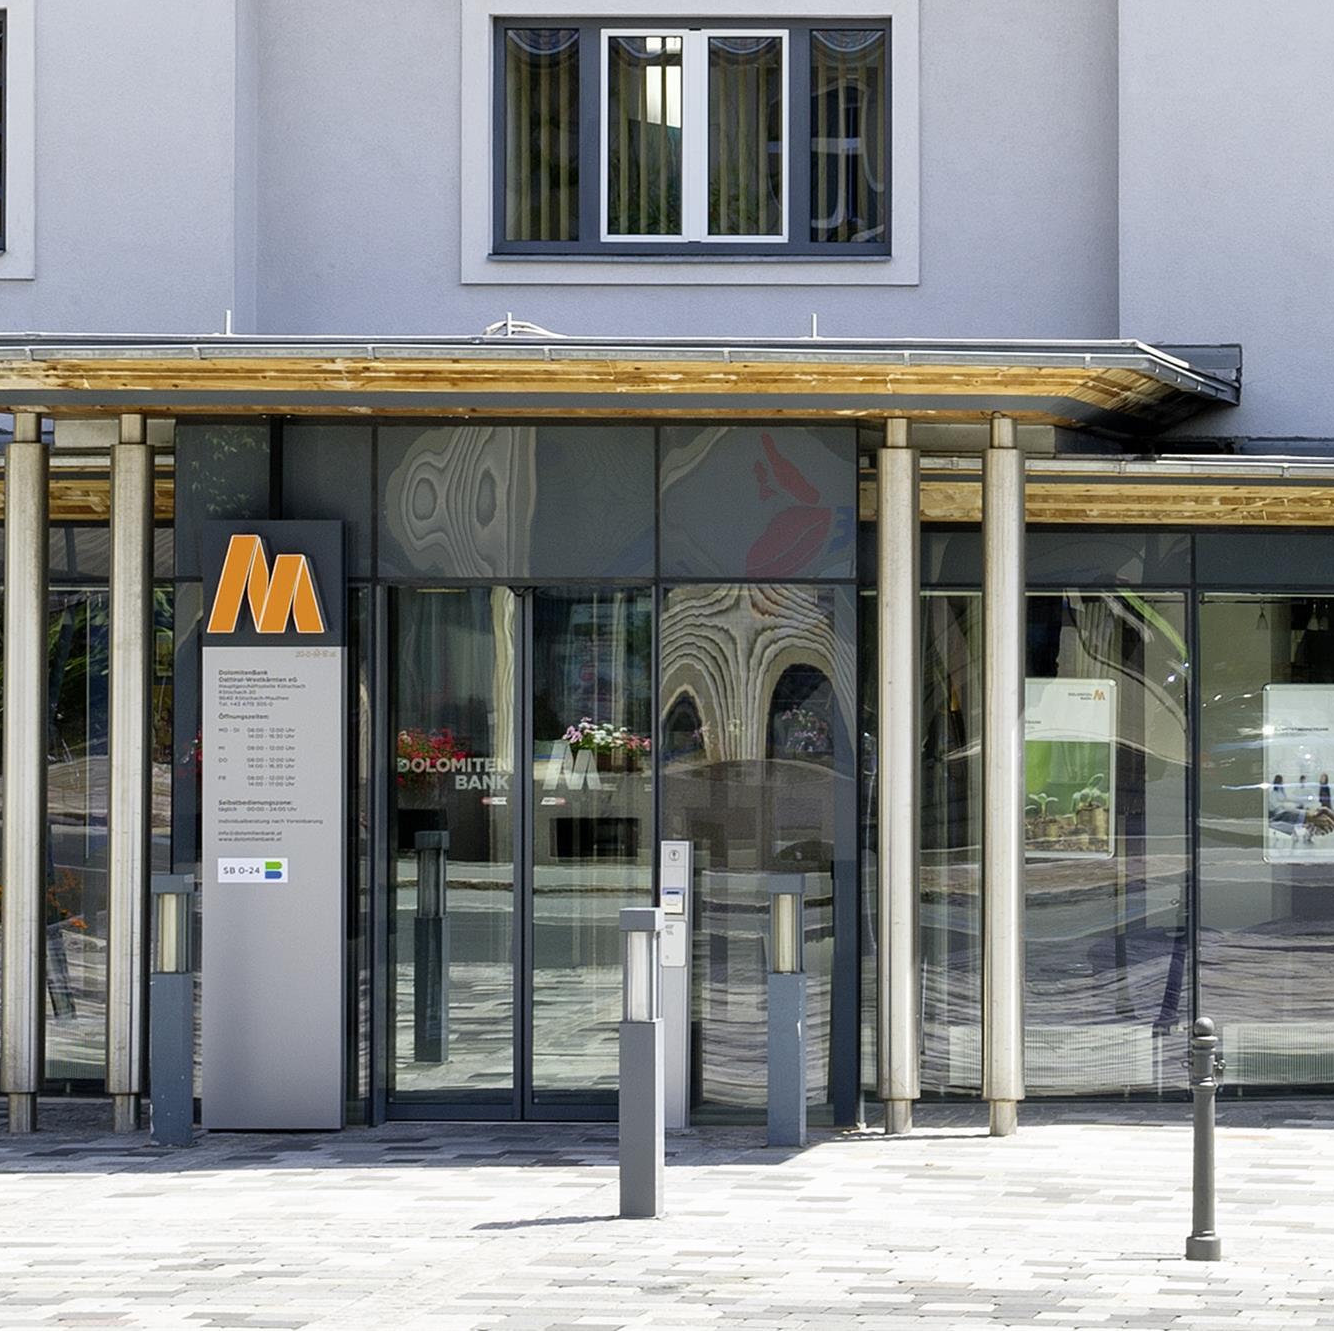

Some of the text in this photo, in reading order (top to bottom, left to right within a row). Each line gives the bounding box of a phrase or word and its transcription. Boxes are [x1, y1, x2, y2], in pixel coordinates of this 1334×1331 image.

[397, 757, 514, 774] DOLOMITEN
[455, 774, 511, 790] BANK
[223, 867, 236, 875] SB
